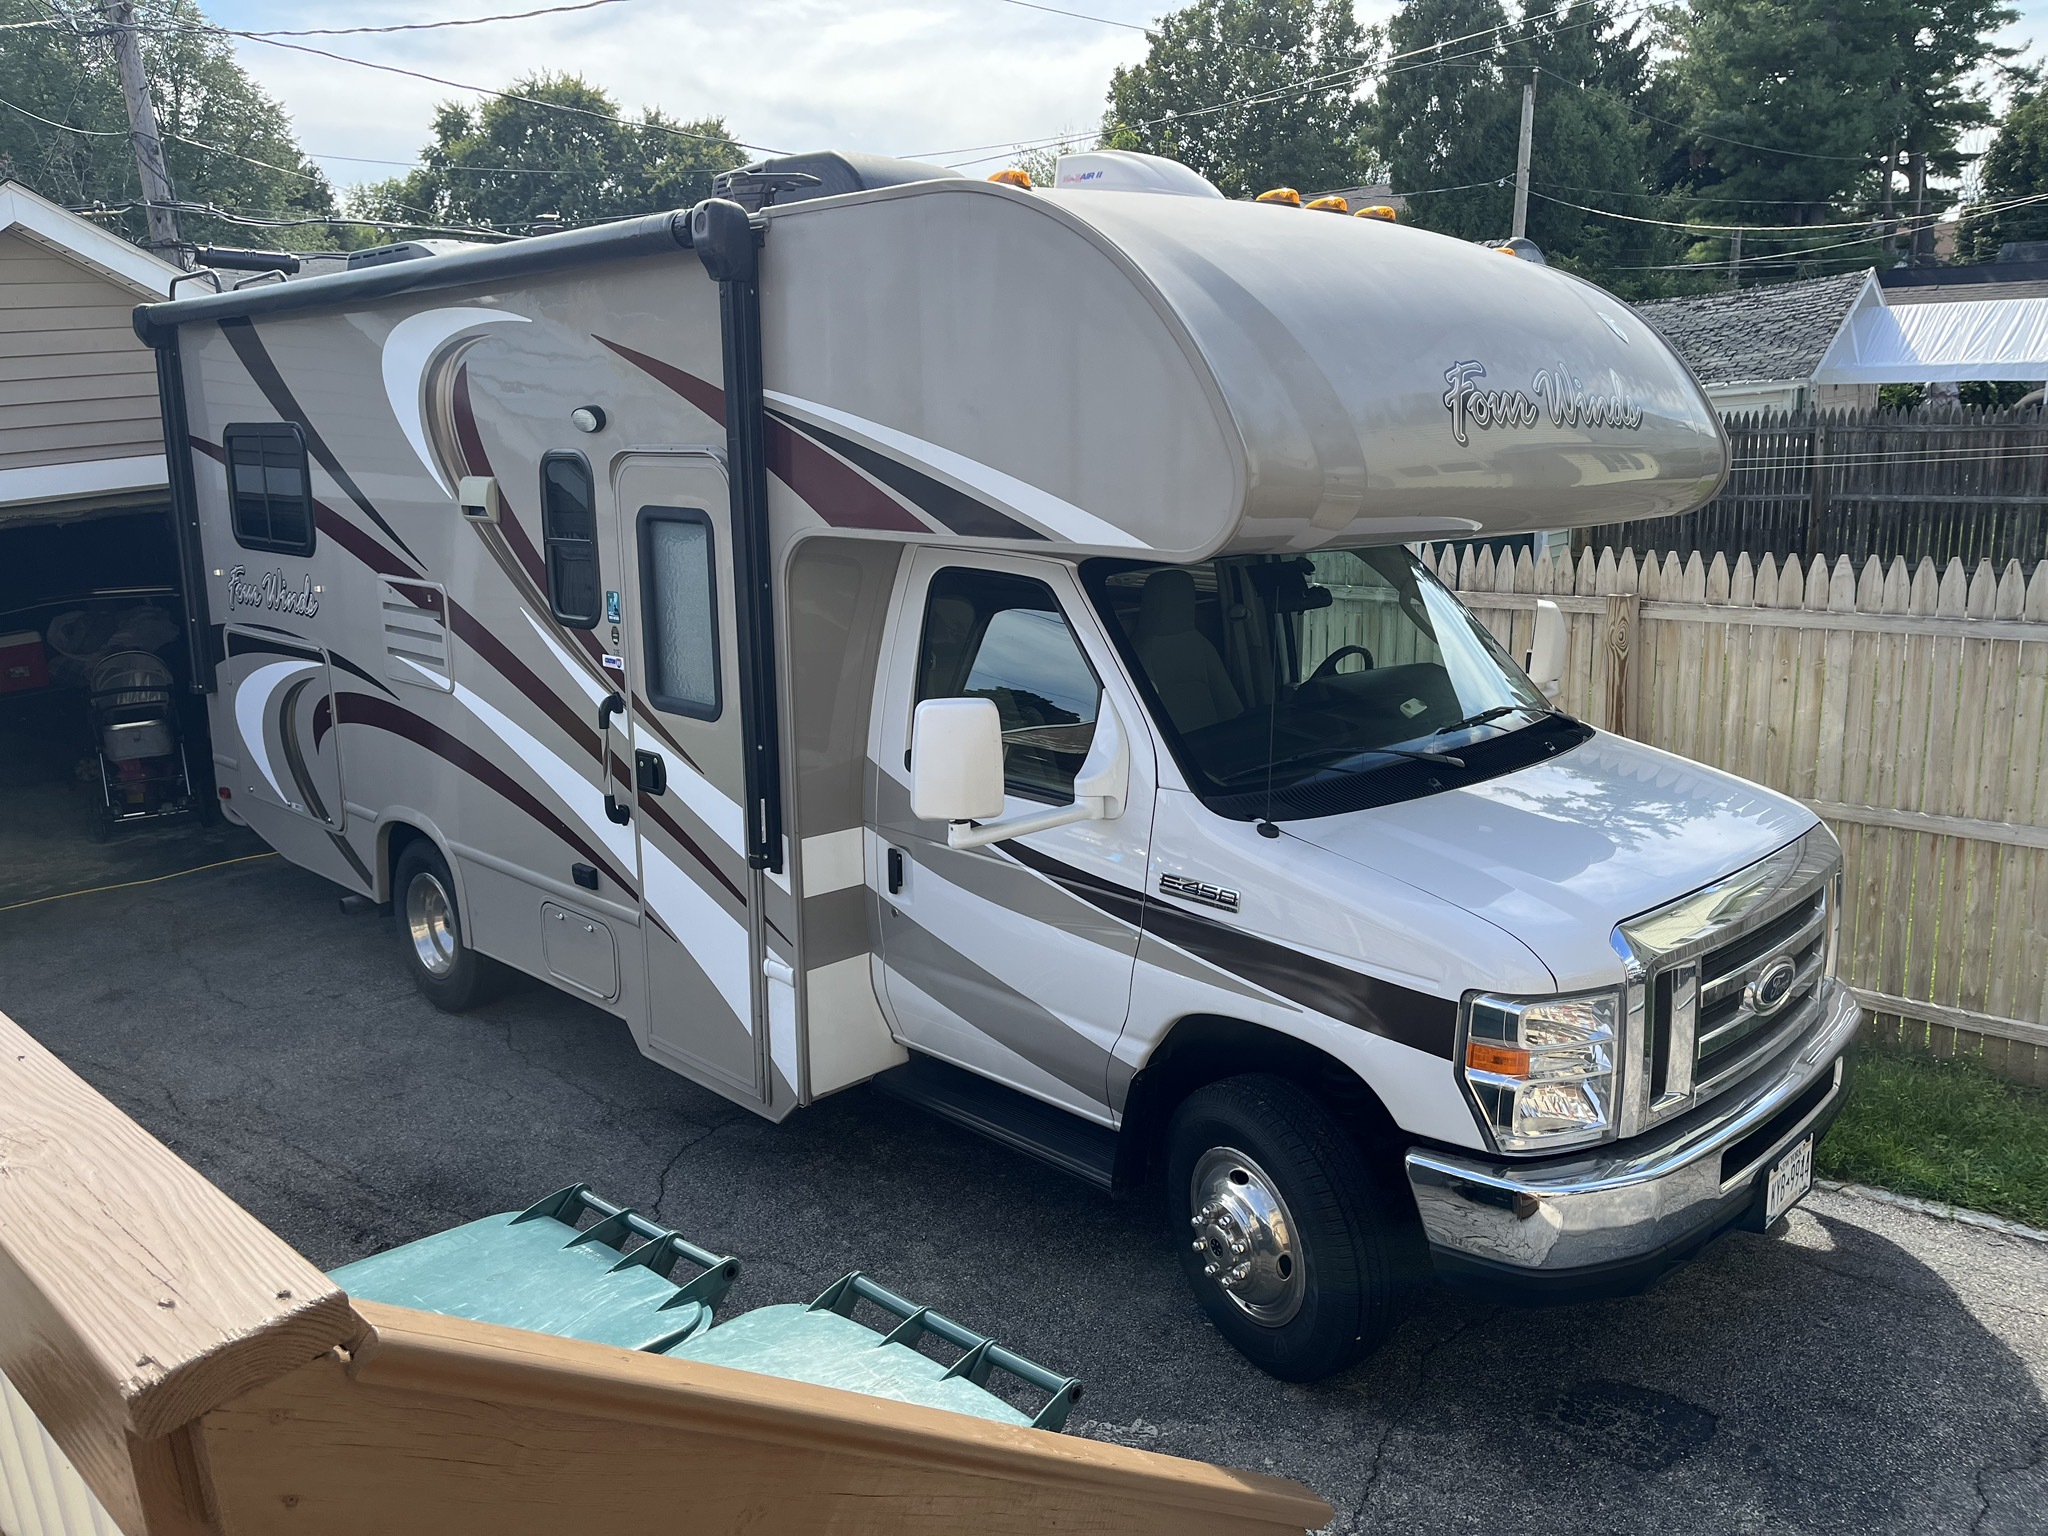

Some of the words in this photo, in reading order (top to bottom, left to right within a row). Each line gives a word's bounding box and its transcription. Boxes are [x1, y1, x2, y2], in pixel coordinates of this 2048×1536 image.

[1443, 360, 1539, 447] Four
[1532, 361, 1643, 431] Winds
[228, 565, 262, 611] Four
[262, 568, 319, 618] Winds
